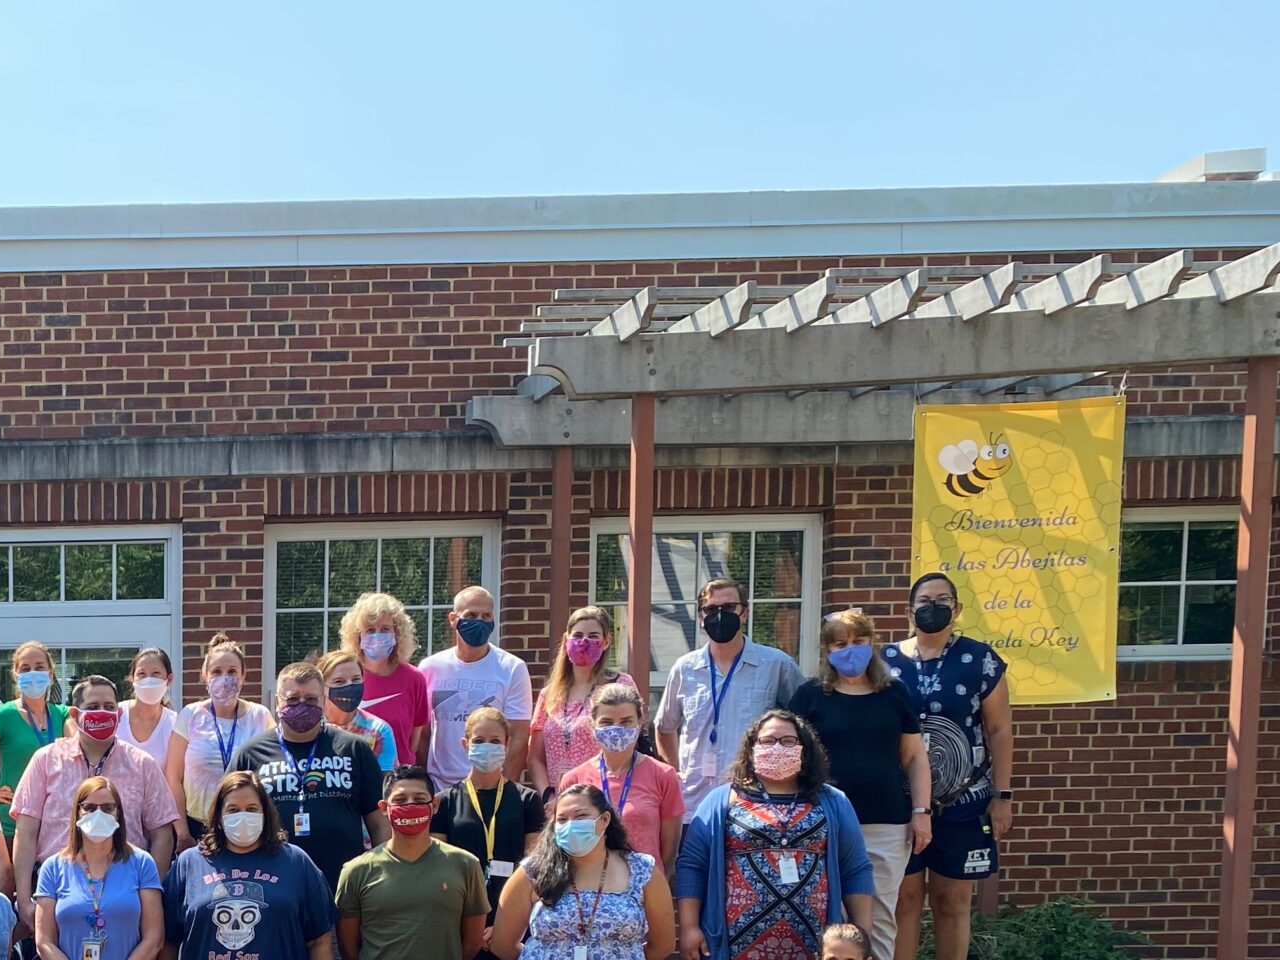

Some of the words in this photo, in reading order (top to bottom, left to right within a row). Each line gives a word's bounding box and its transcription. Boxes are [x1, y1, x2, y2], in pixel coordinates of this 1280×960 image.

[943, 506, 1078, 532] Bienvenida
[939, 560, 950, 572] a
[957, 551, 986, 571] las
[993, 547, 1087, 571] Abejitas
[984, 591, 1008, 610] de
[1013, 589, 1033, 609] la
[1030, 627, 1080, 651] Key
[298, 756, 353, 771] GRADE
[261, 771, 353, 793] STRNG
[967, 848, 991, 861] KEY
